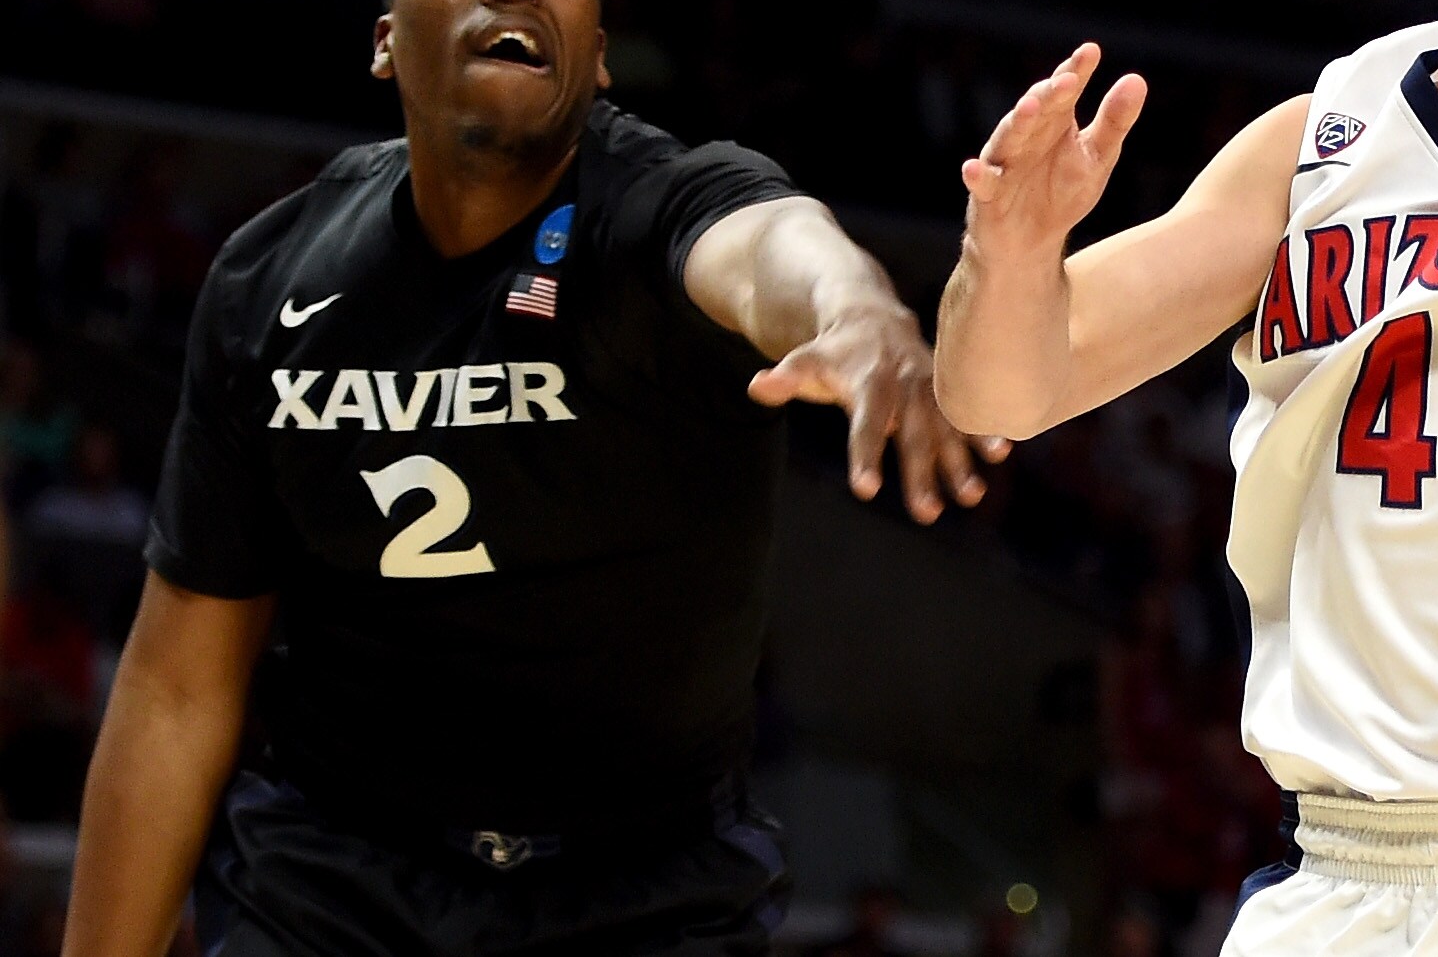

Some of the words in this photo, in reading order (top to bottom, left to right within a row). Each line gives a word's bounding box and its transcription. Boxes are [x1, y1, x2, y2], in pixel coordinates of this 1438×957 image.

[1316, 114, 1364, 144] PAC
[1317, 130, 1345, 150] 12
[267, 361, 579, 432] XAVIER
[1335, 310, 1437, 510] 4
[359, 454, 497, 579] 2
